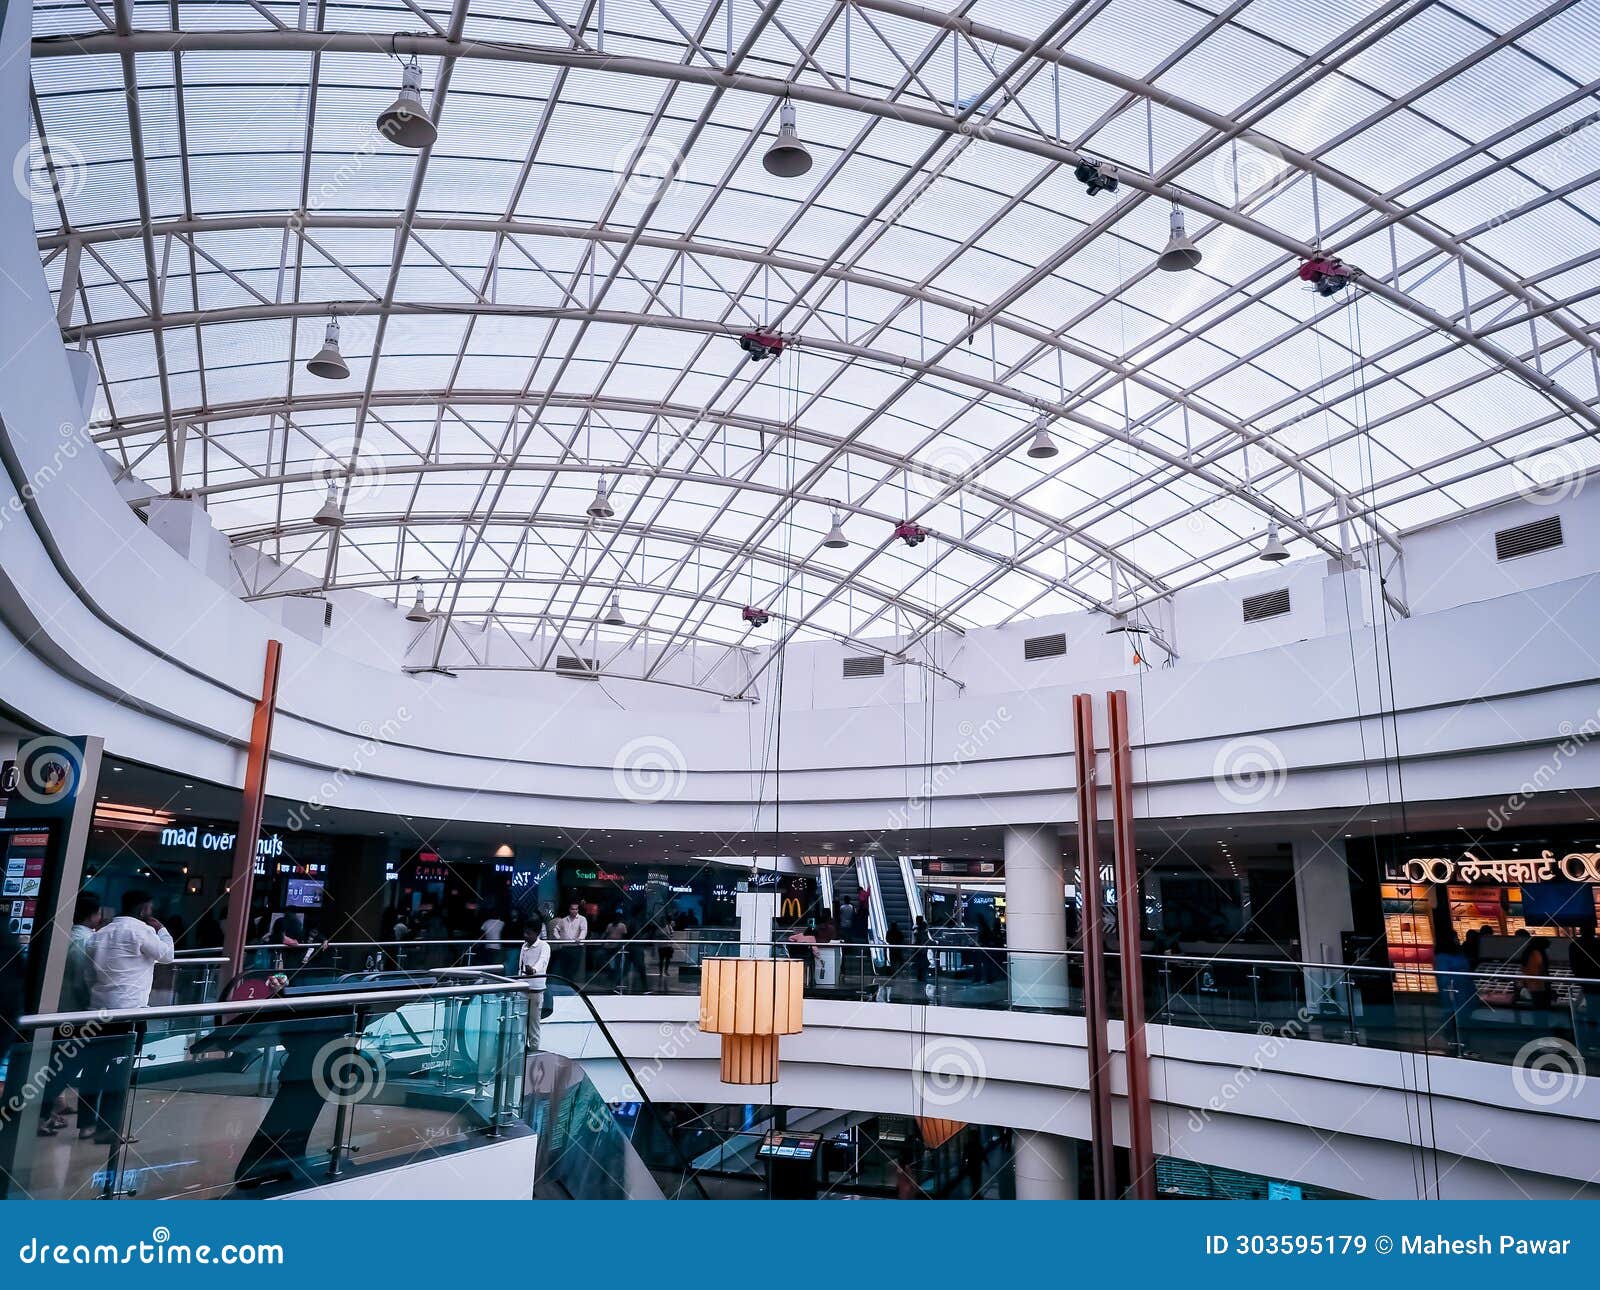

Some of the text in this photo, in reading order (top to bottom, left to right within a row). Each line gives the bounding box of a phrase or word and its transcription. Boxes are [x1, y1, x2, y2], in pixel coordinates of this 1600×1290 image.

[161, 827, 283, 858] mad over nuts
[1457, 850, 1556, 883] लेन्सकार्ट
